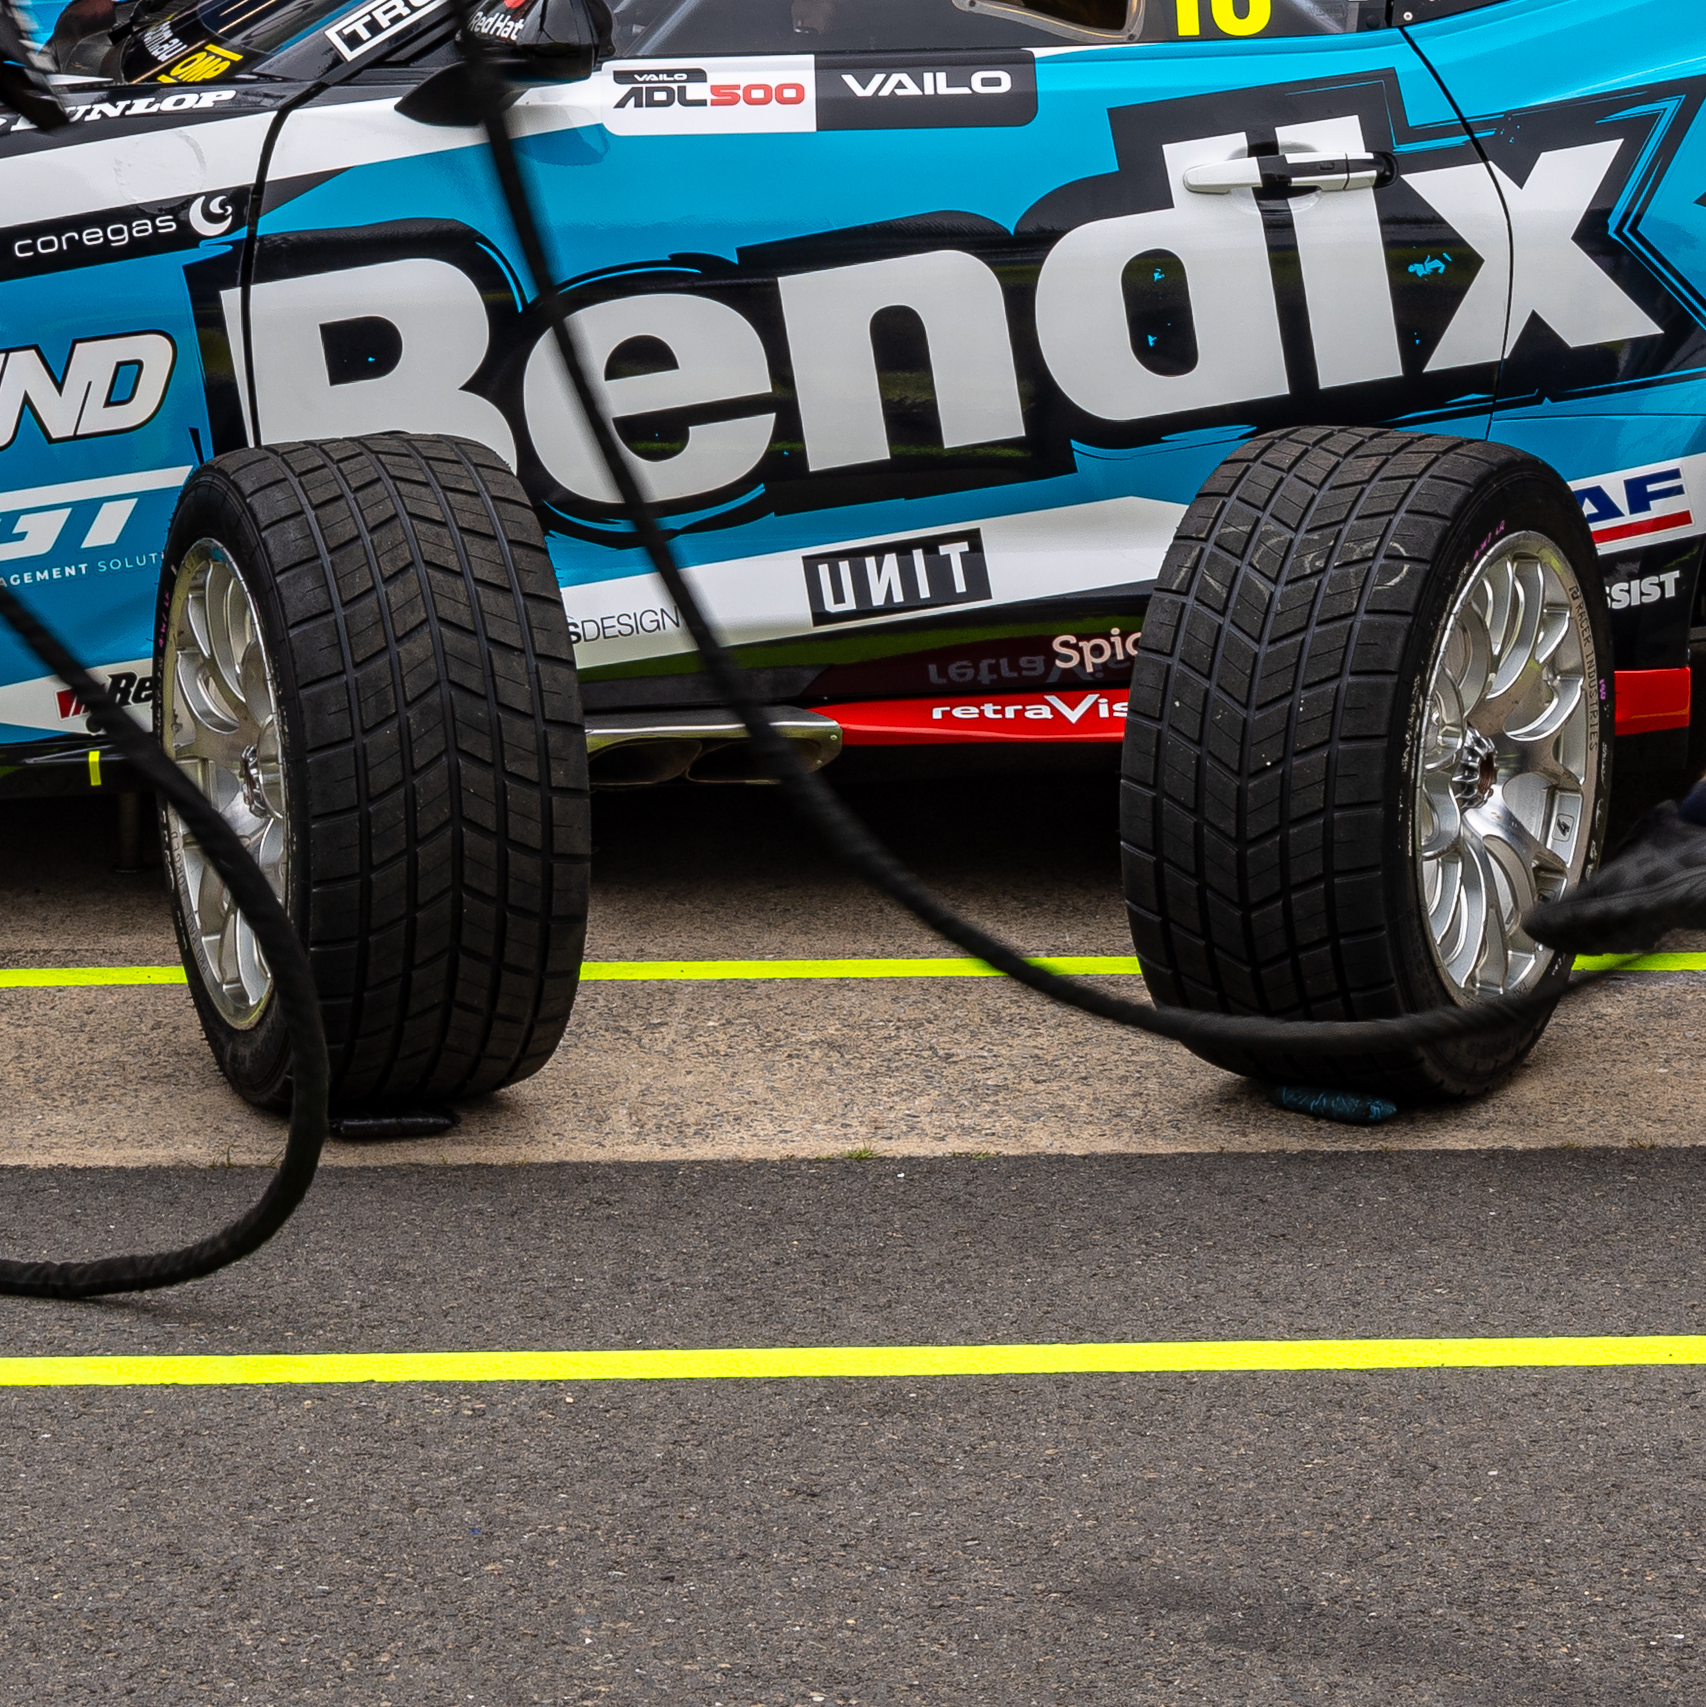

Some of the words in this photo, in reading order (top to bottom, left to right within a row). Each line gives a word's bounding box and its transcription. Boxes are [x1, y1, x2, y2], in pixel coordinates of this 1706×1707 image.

[632, 71, 688, 82] VAILO
[841, 69, 1014, 97] VAILO
[13, 212, 177, 258] coregas
[220, 114, 1667, 507] Bendix
[1573, 468, 1686, 524] AF
[816, 540, 974, 616] UNIT
